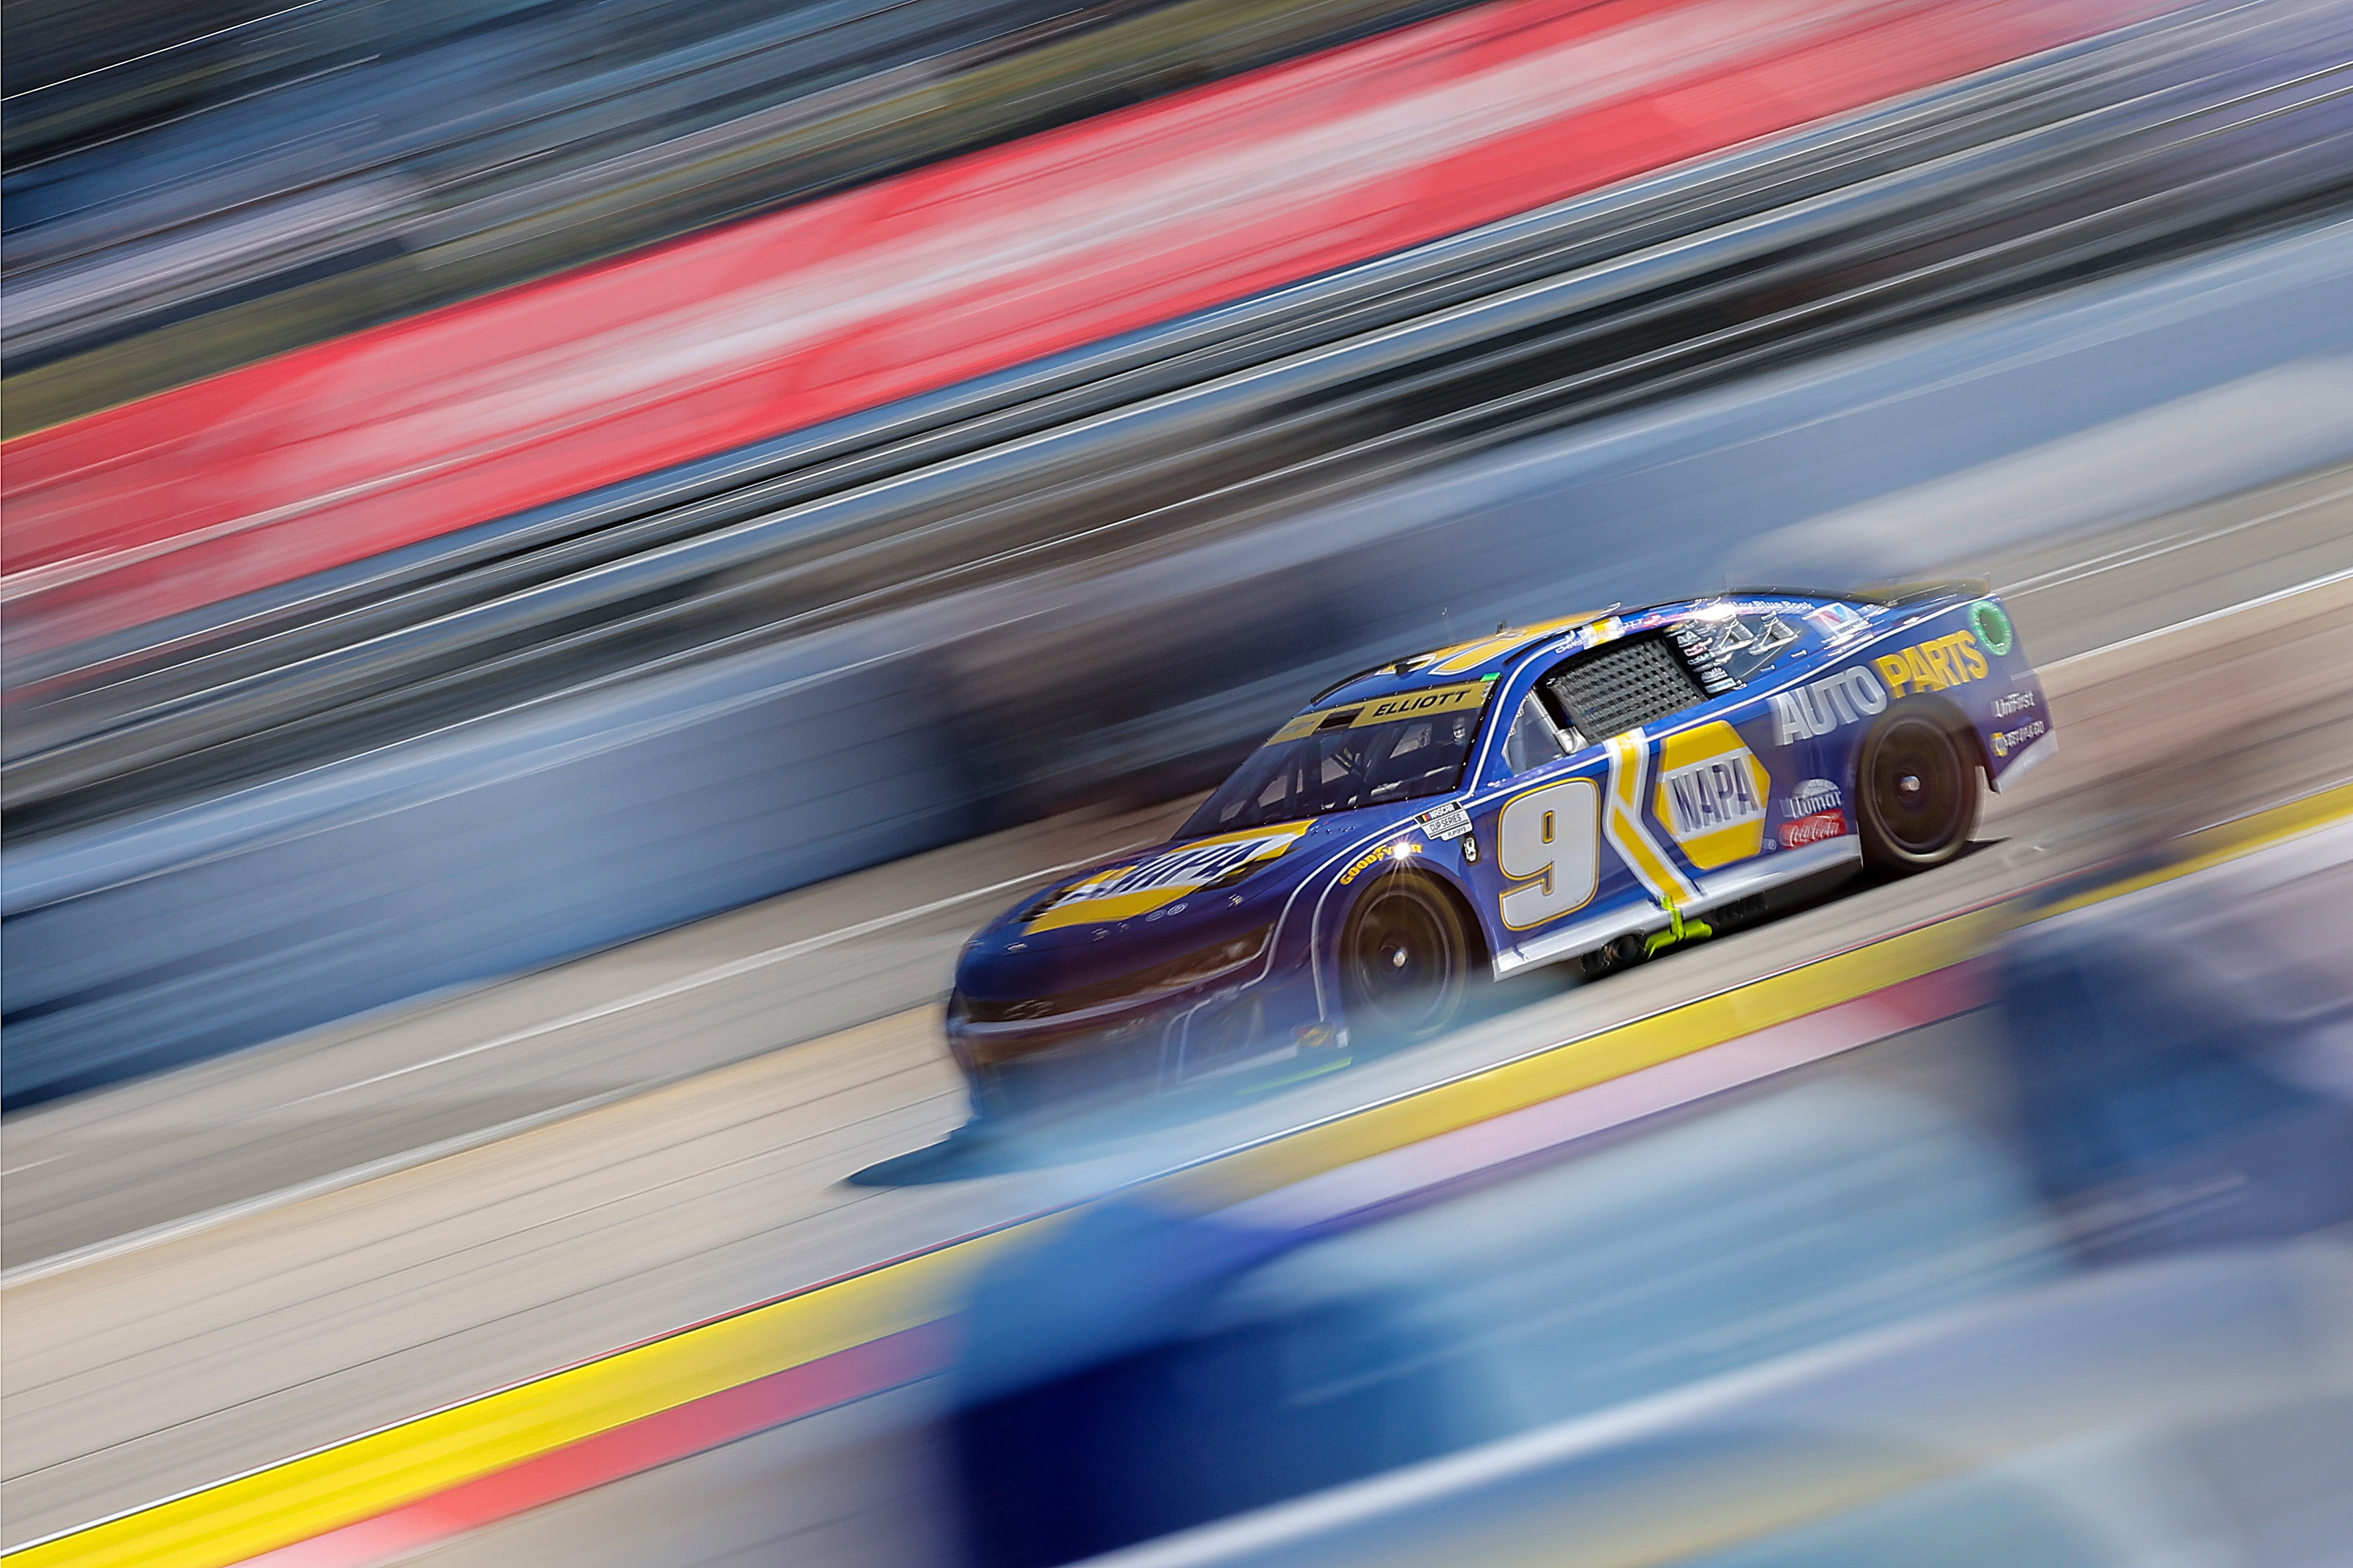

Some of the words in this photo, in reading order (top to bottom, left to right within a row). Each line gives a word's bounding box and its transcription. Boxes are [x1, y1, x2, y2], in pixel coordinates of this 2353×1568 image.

[1753, 600, 1780, 609] Blue
[1782, 601, 1815, 610] Book
[1874, 629, 1990, 699] PARTS
[1372, 689, 1471, 718] ELLIOTT
[1771, 664, 1888, 746] AUTO
[1429, 803, 1455, 819] NASCAR
[1671, 755, 1760, 833] NAPA
[1429, 822, 1442, 833] CUP
[1442, 813, 1462, 828] SERIES
[1340, 843, 1422, 885] GOODYR
[1498, 776, 1601, 932] 9
